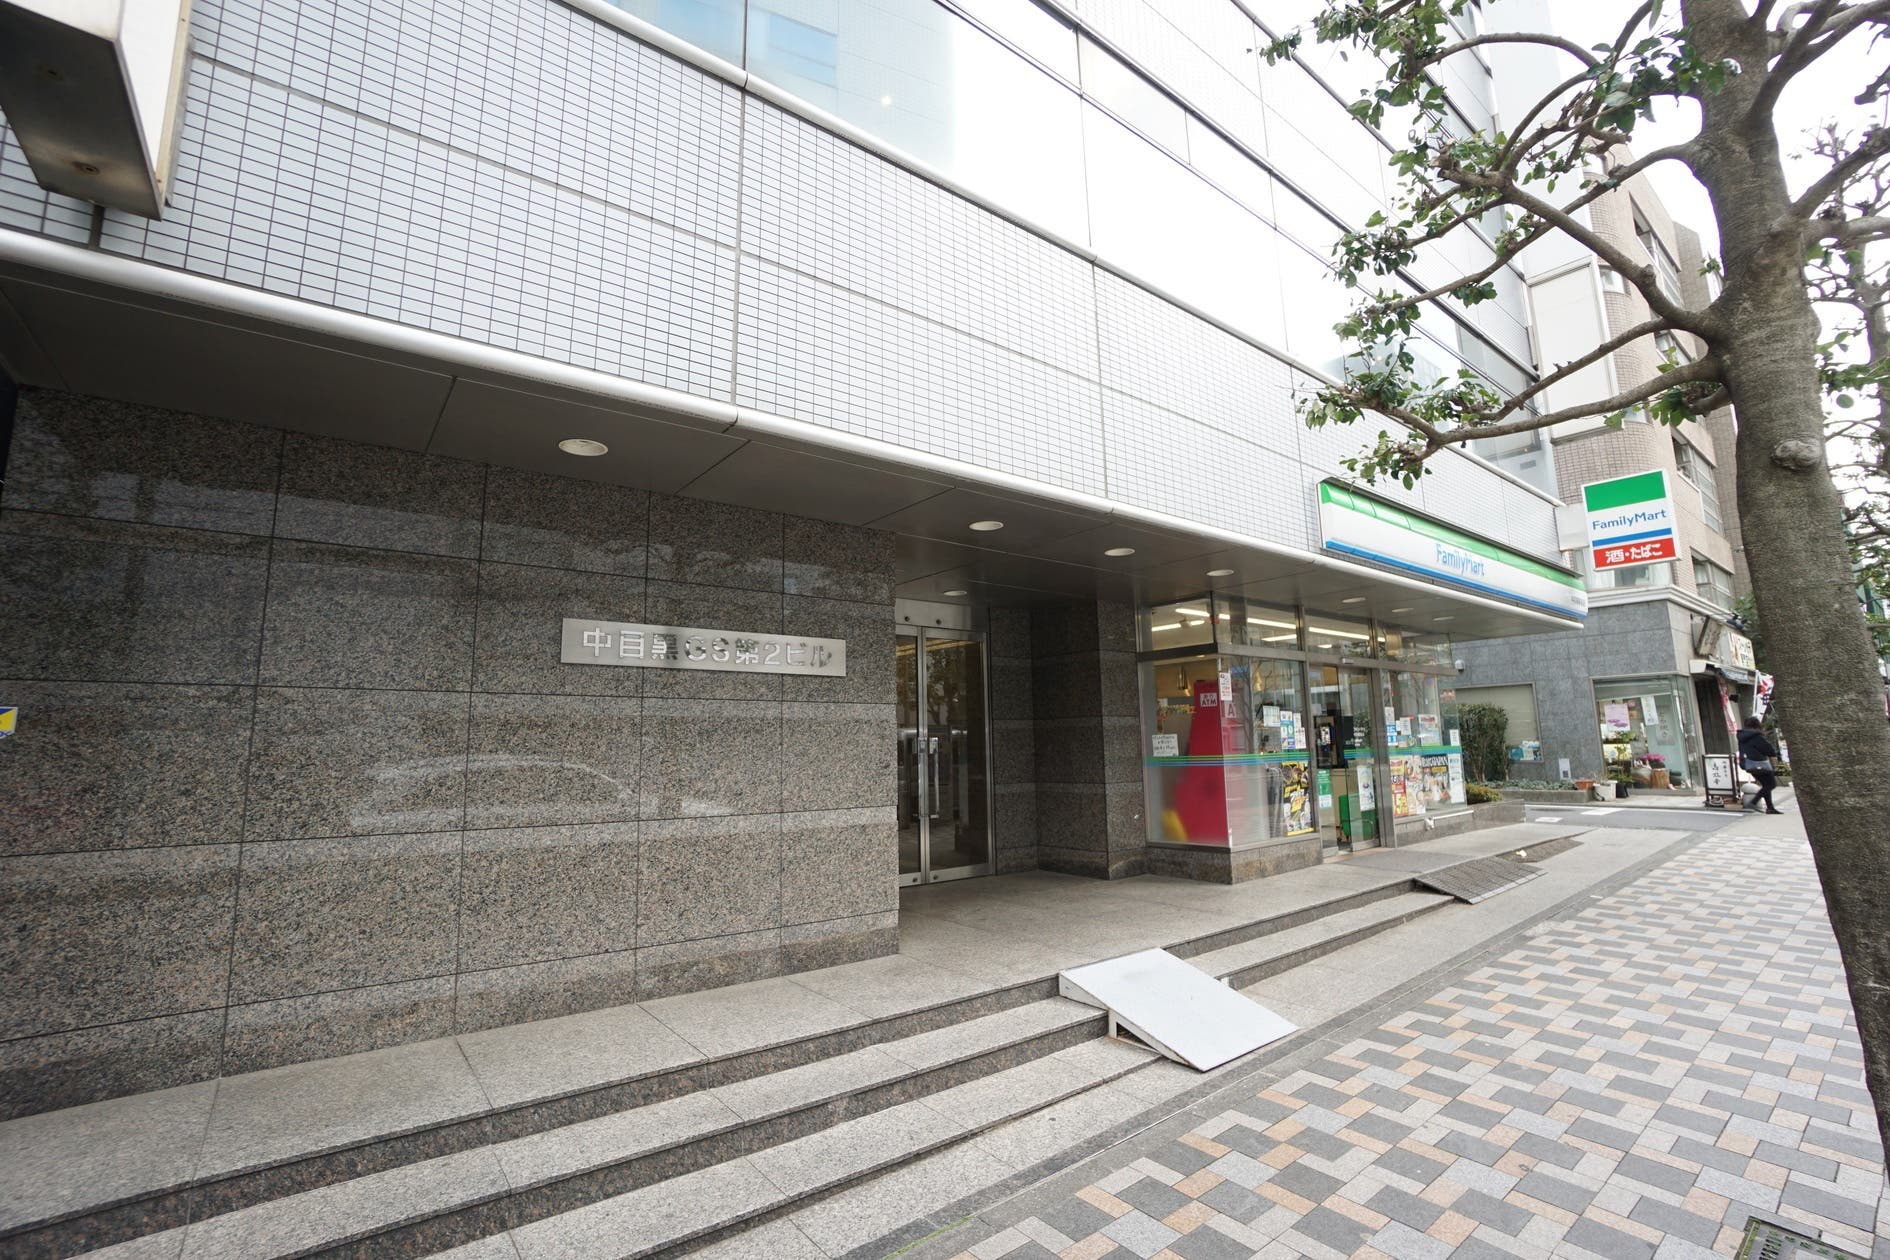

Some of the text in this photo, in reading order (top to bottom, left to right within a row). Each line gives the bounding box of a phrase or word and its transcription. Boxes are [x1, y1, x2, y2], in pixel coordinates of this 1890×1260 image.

[1592, 509, 1667, 530] FamilyMart
[1435, 543, 1485, 576] FamilyMart
[1605, 543, 1663, 564] 酒・たばこ
